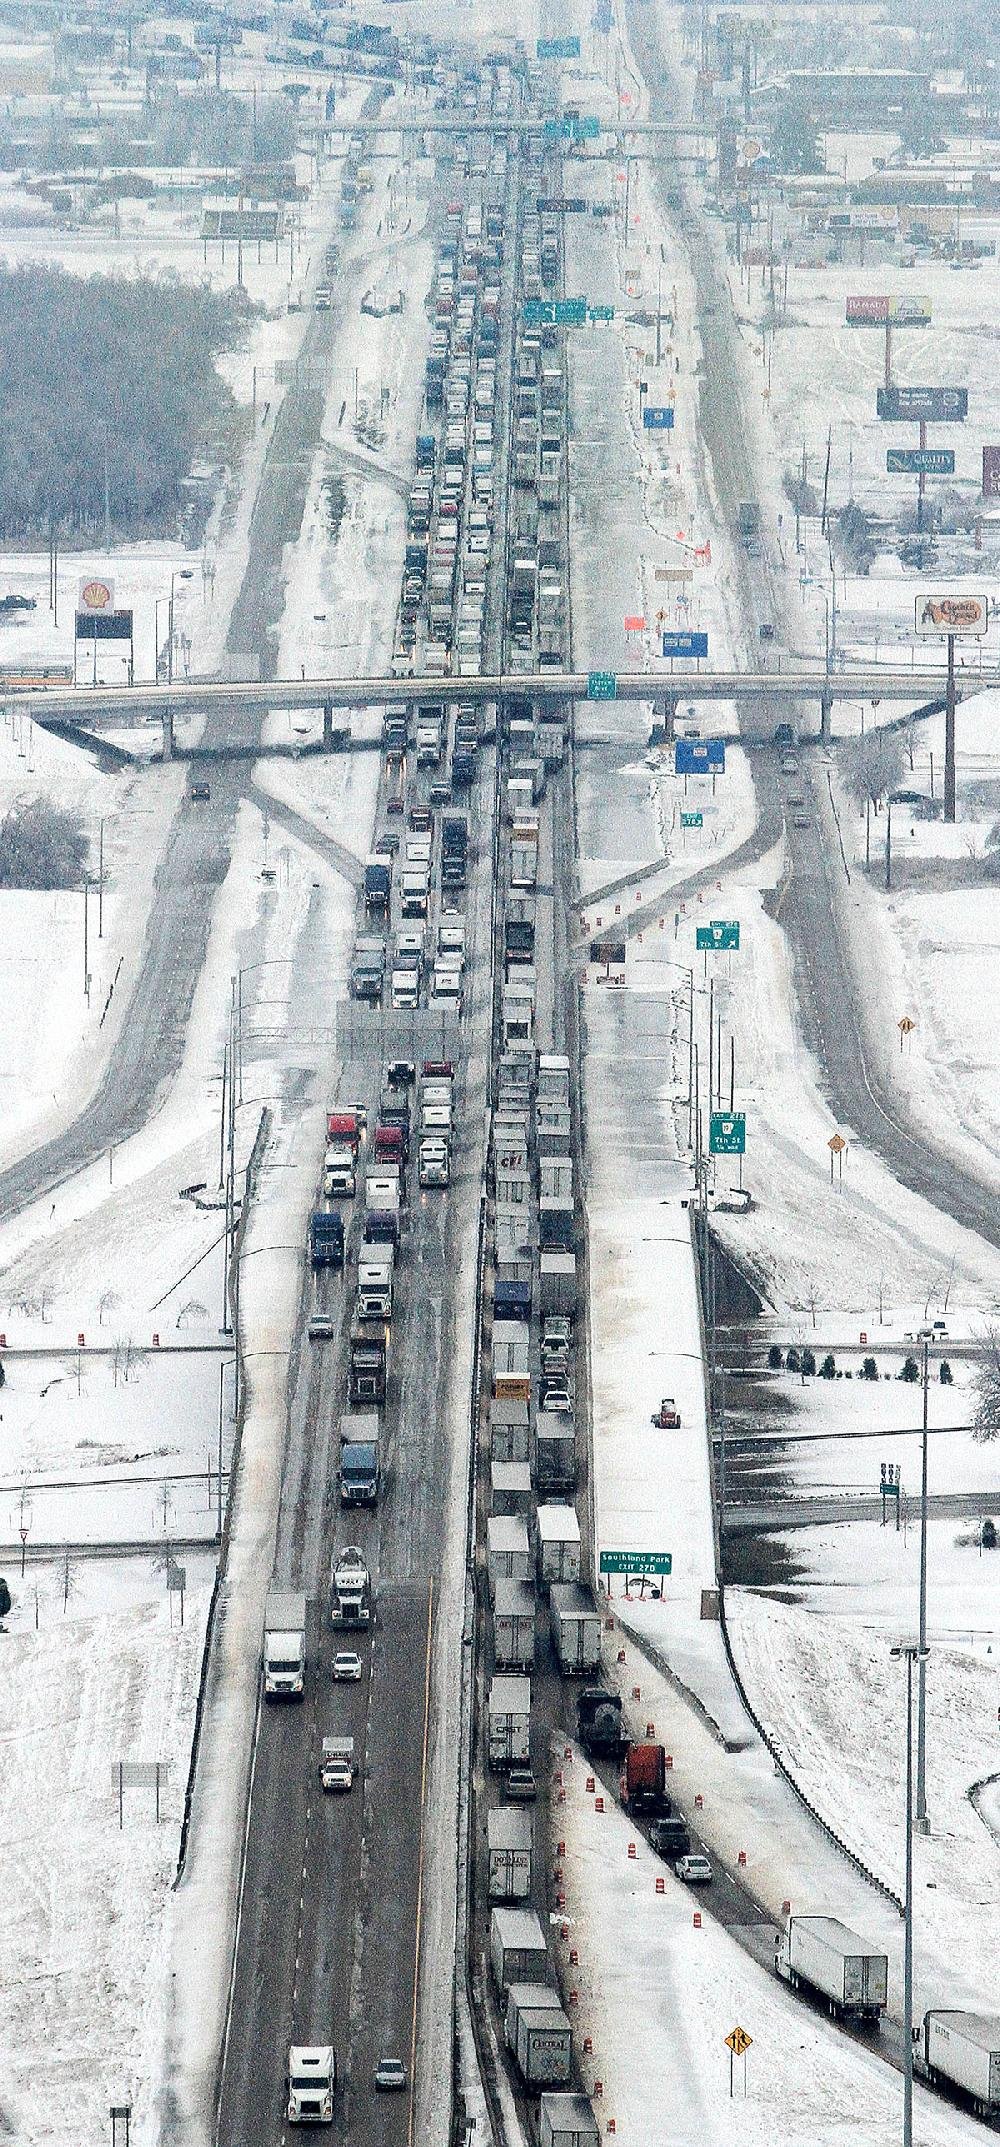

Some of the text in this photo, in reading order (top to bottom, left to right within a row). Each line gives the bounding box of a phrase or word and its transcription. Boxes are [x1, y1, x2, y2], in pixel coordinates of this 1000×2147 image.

[714, 1136, 742, 1144] 7th St
[602, 1553, 670, 1563] Southland Park
